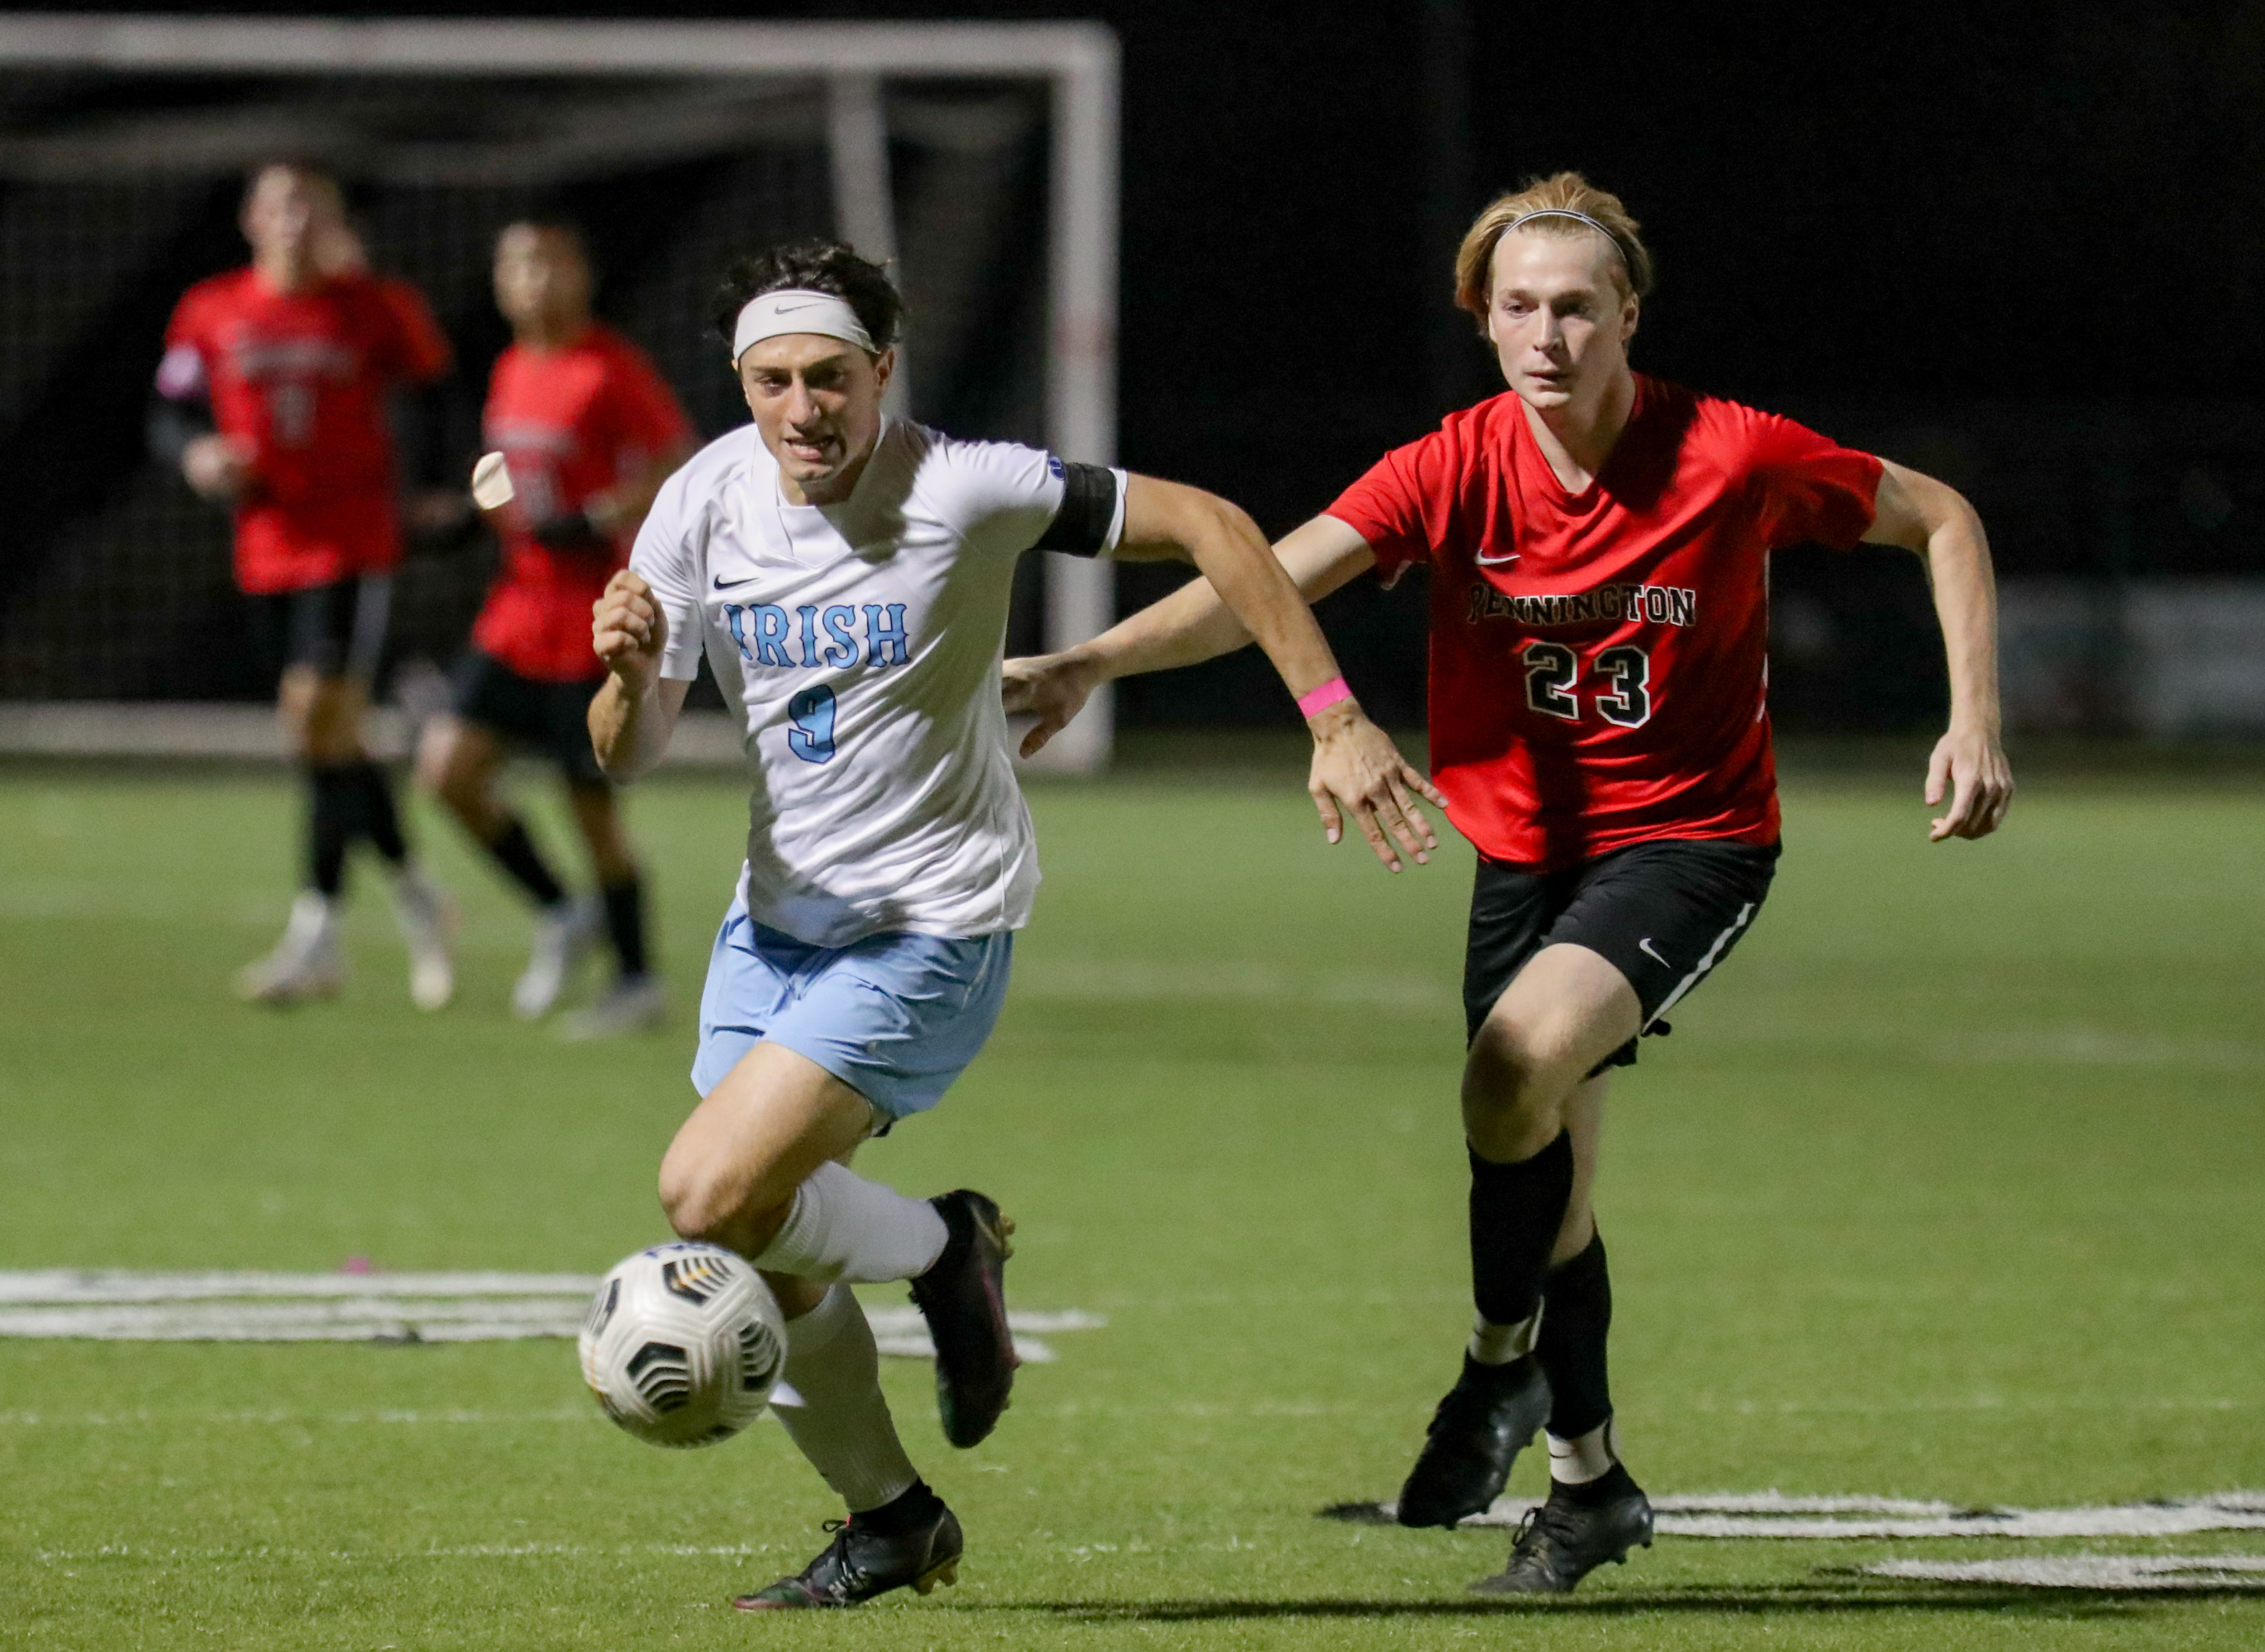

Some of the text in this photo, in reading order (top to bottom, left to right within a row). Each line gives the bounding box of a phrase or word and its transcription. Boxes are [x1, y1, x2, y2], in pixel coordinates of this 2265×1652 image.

[1468, 583, 1696, 626] PENNINGTON
[788, 684, 836, 764] 9
[1523, 642, 1651, 729] 23
